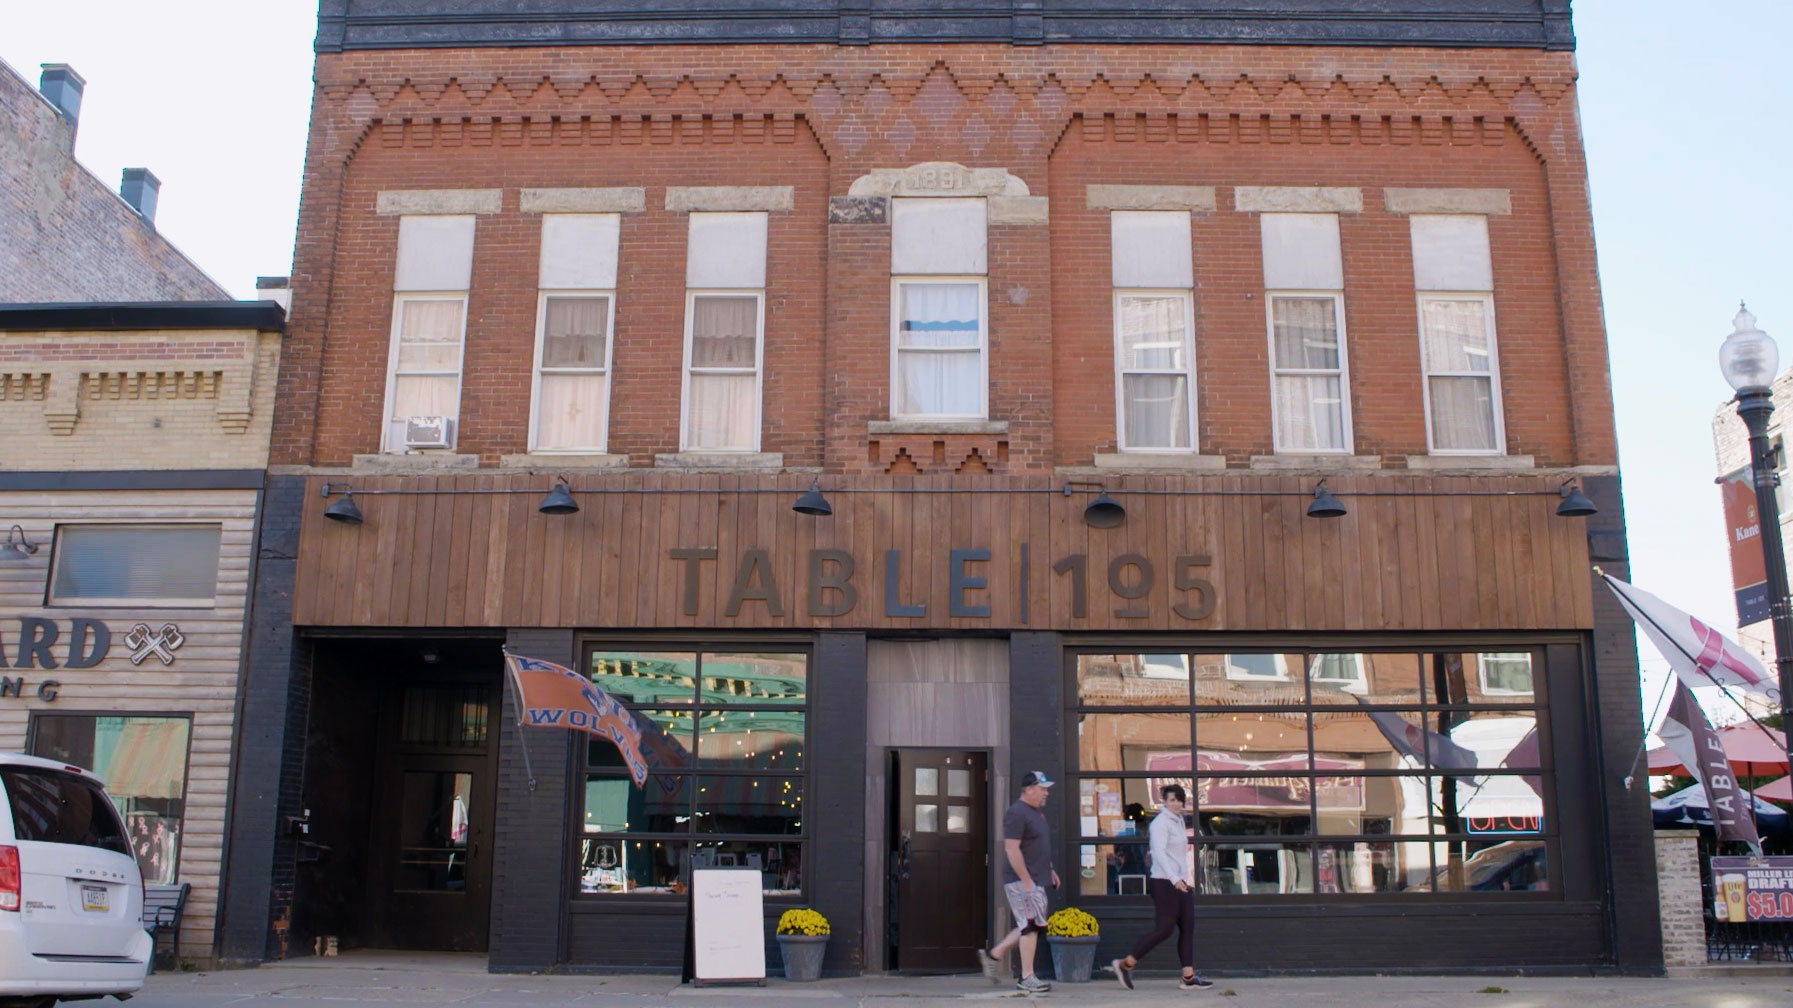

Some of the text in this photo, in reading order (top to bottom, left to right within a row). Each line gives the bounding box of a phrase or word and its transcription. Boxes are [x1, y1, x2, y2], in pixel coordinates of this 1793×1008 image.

[912, 169, 964, 190] 1891
[1736, 524, 1760, 541] Kane
[670, 547, 990, 618] TABLE
[0, 616, 110, 669] RD
[1747, 870, 1793, 878] MILLER LI
